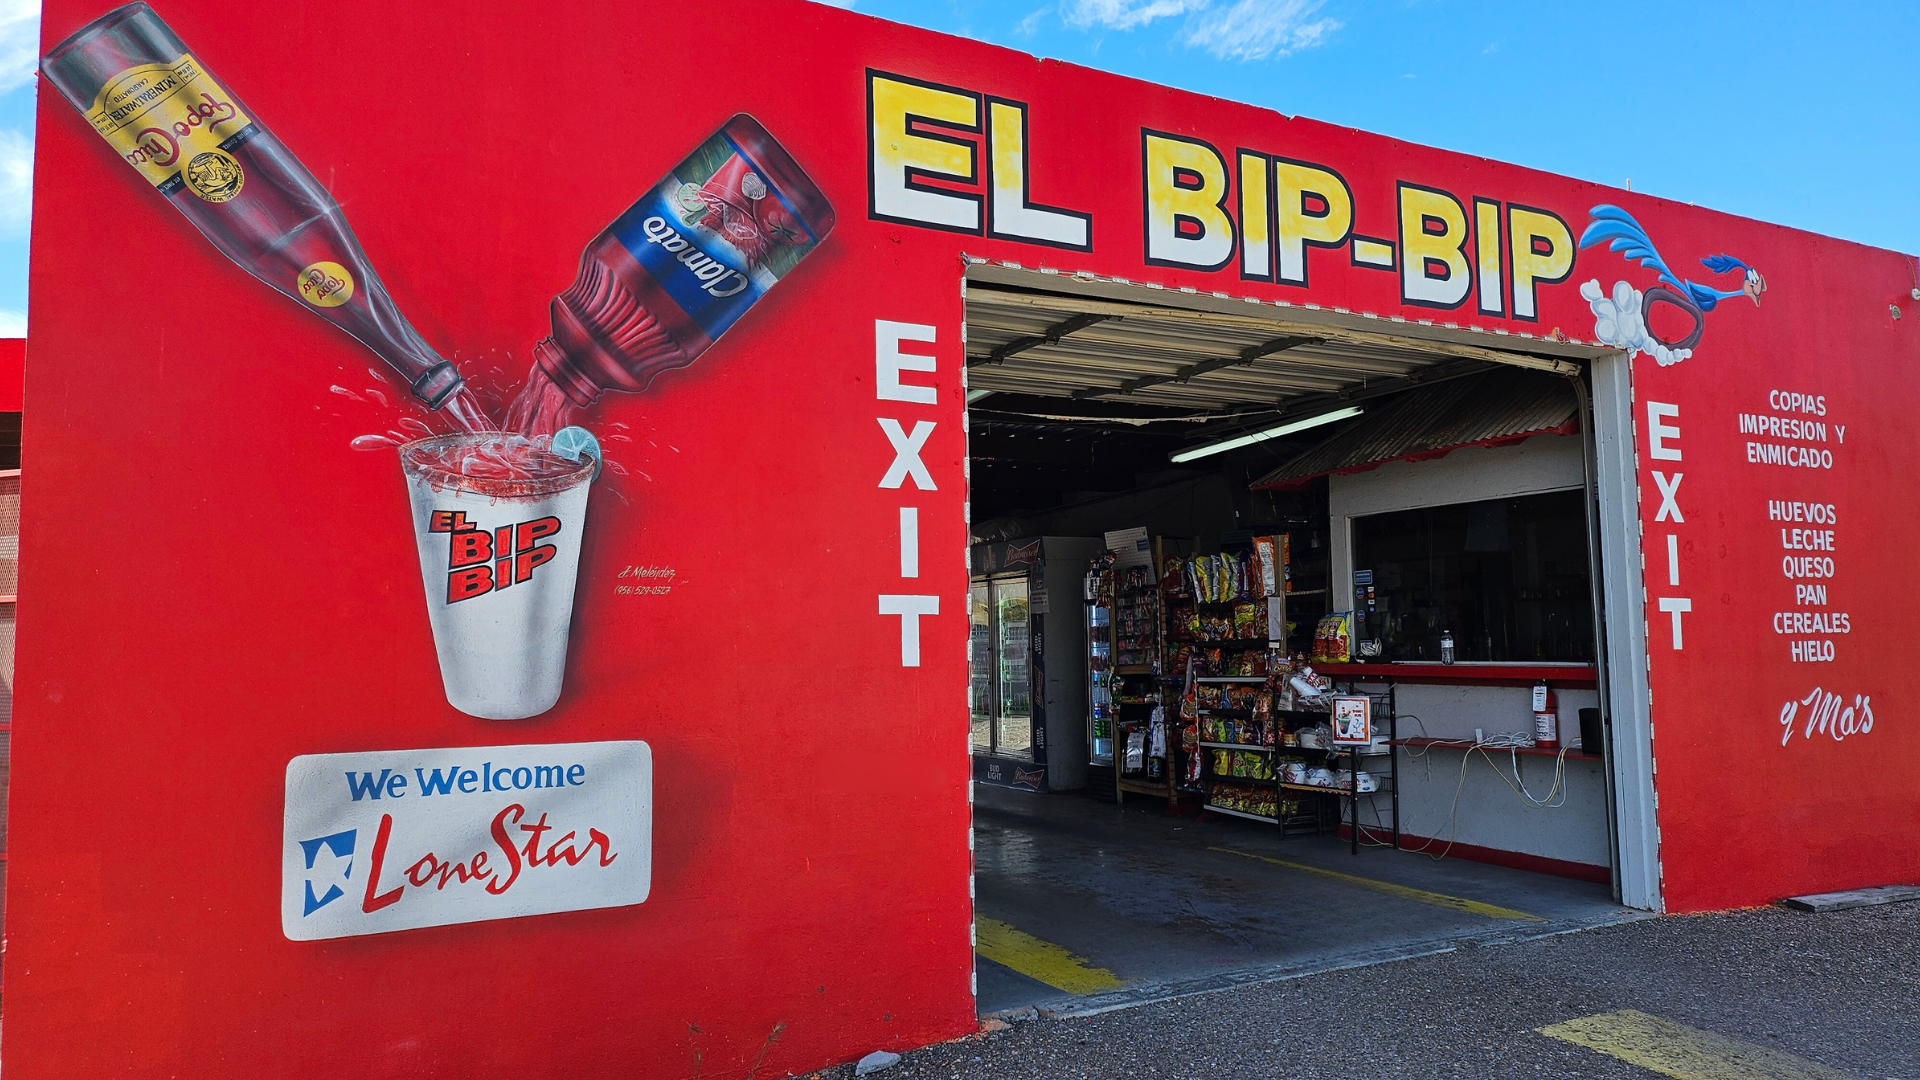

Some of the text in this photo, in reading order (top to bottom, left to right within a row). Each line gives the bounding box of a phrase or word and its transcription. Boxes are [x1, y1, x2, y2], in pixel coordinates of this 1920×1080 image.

[173, 93, 236, 135] Topo
[866, 67, 1576, 323] EL BIP-BIP
[643, 216, 749, 297] Clamato
[1769, 389, 1827, 417] COPIAS
[1739, 413, 1846, 444] IMPRESION Y
[1747, 442, 1833, 469] ENMICADO
[875, 319, 939, 667] EXIT
[428, 509, 478, 533] EL
[1647, 401, 1692, 650] EXIT
[1768, 500, 1837, 525] HUEVOS
[448, 515, 562, 571] BIP
[1781, 528, 1835, 551] LECHE
[446, 544, 557, 605] BIP
[1782, 555, 1835, 580] QUESO
[614, 585, 635, 595] (956)
[1796, 584, 1827, 605] PAN
[1773, 612, 1851, 634] CEREALES
[1791, 640, 1835, 662] HIELO
[344, 761, 586, 801] We Welcome
[987, 771, 1002, 781] LIGHT
[989, 764, 1000, 772] BUD
